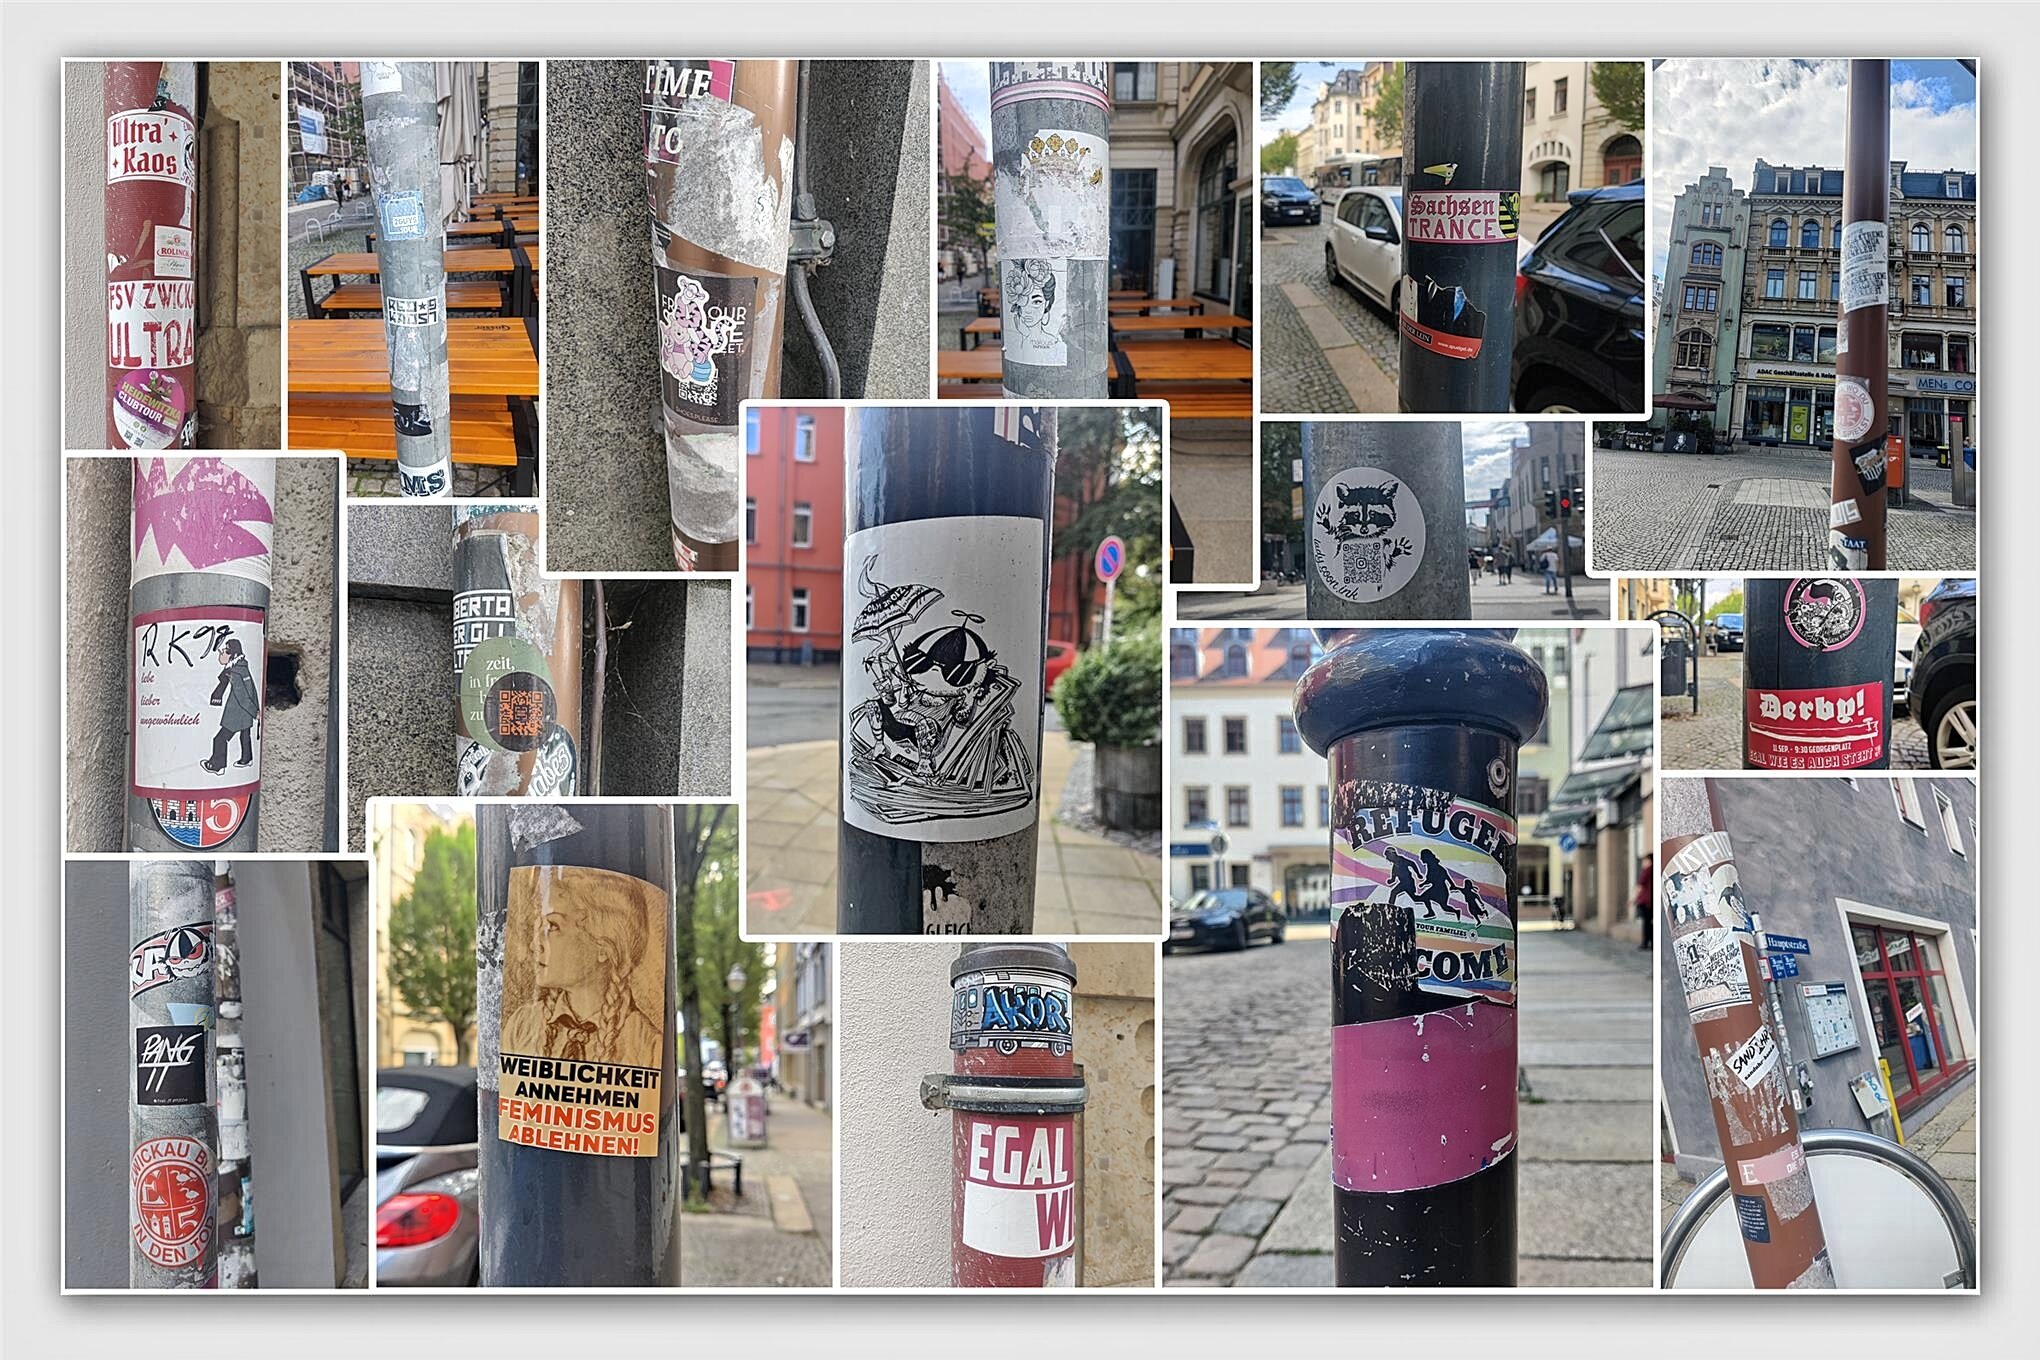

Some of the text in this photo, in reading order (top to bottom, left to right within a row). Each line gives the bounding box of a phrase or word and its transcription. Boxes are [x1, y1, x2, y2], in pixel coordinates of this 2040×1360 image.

[123, 146, 177, 175] Kaos
[1410, 194, 1495, 219] Sachsen
[1409, 218, 1497, 239] TRANCE
[109, 282, 194, 310] FSV ZWICK
[110, 319, 193, 367] ULTRA
[118, 390, 163, 423] CLUBTOUR
[486, 656, 515, 671] zeit,
[1760, 688, 1865, 724] Derby!
[140, 712, 201, 729] ungewöhnlich
[1769, 753, 1789, 768] WIE
[1790, 755, 1806, 769] ES
[1808, 753, 1840, 769] AUCH
[1842, 747, 1874, 765] STEHT
[1809, 743, 1852, 754] GEORGENPLATZ
[1416, 923, 1468, 938] YOUR FAMILIES
[1767, 936, 1808, 951] Hauptstraße
[1417, 942, 1509, 981] COME
[500, 1056, 660, 1089] WEIBLICHKEIT
[515, 1081, 640, 1108] ANNEHMEN
[498, 1097, 656, 1135] FEMINISMUS
[508, 1124, 640, 1156] ABLEHNEN!
[968, 1122, 1069, 1185] EGAL
[134, 1215, 214, 1263] IN DEN TOD
